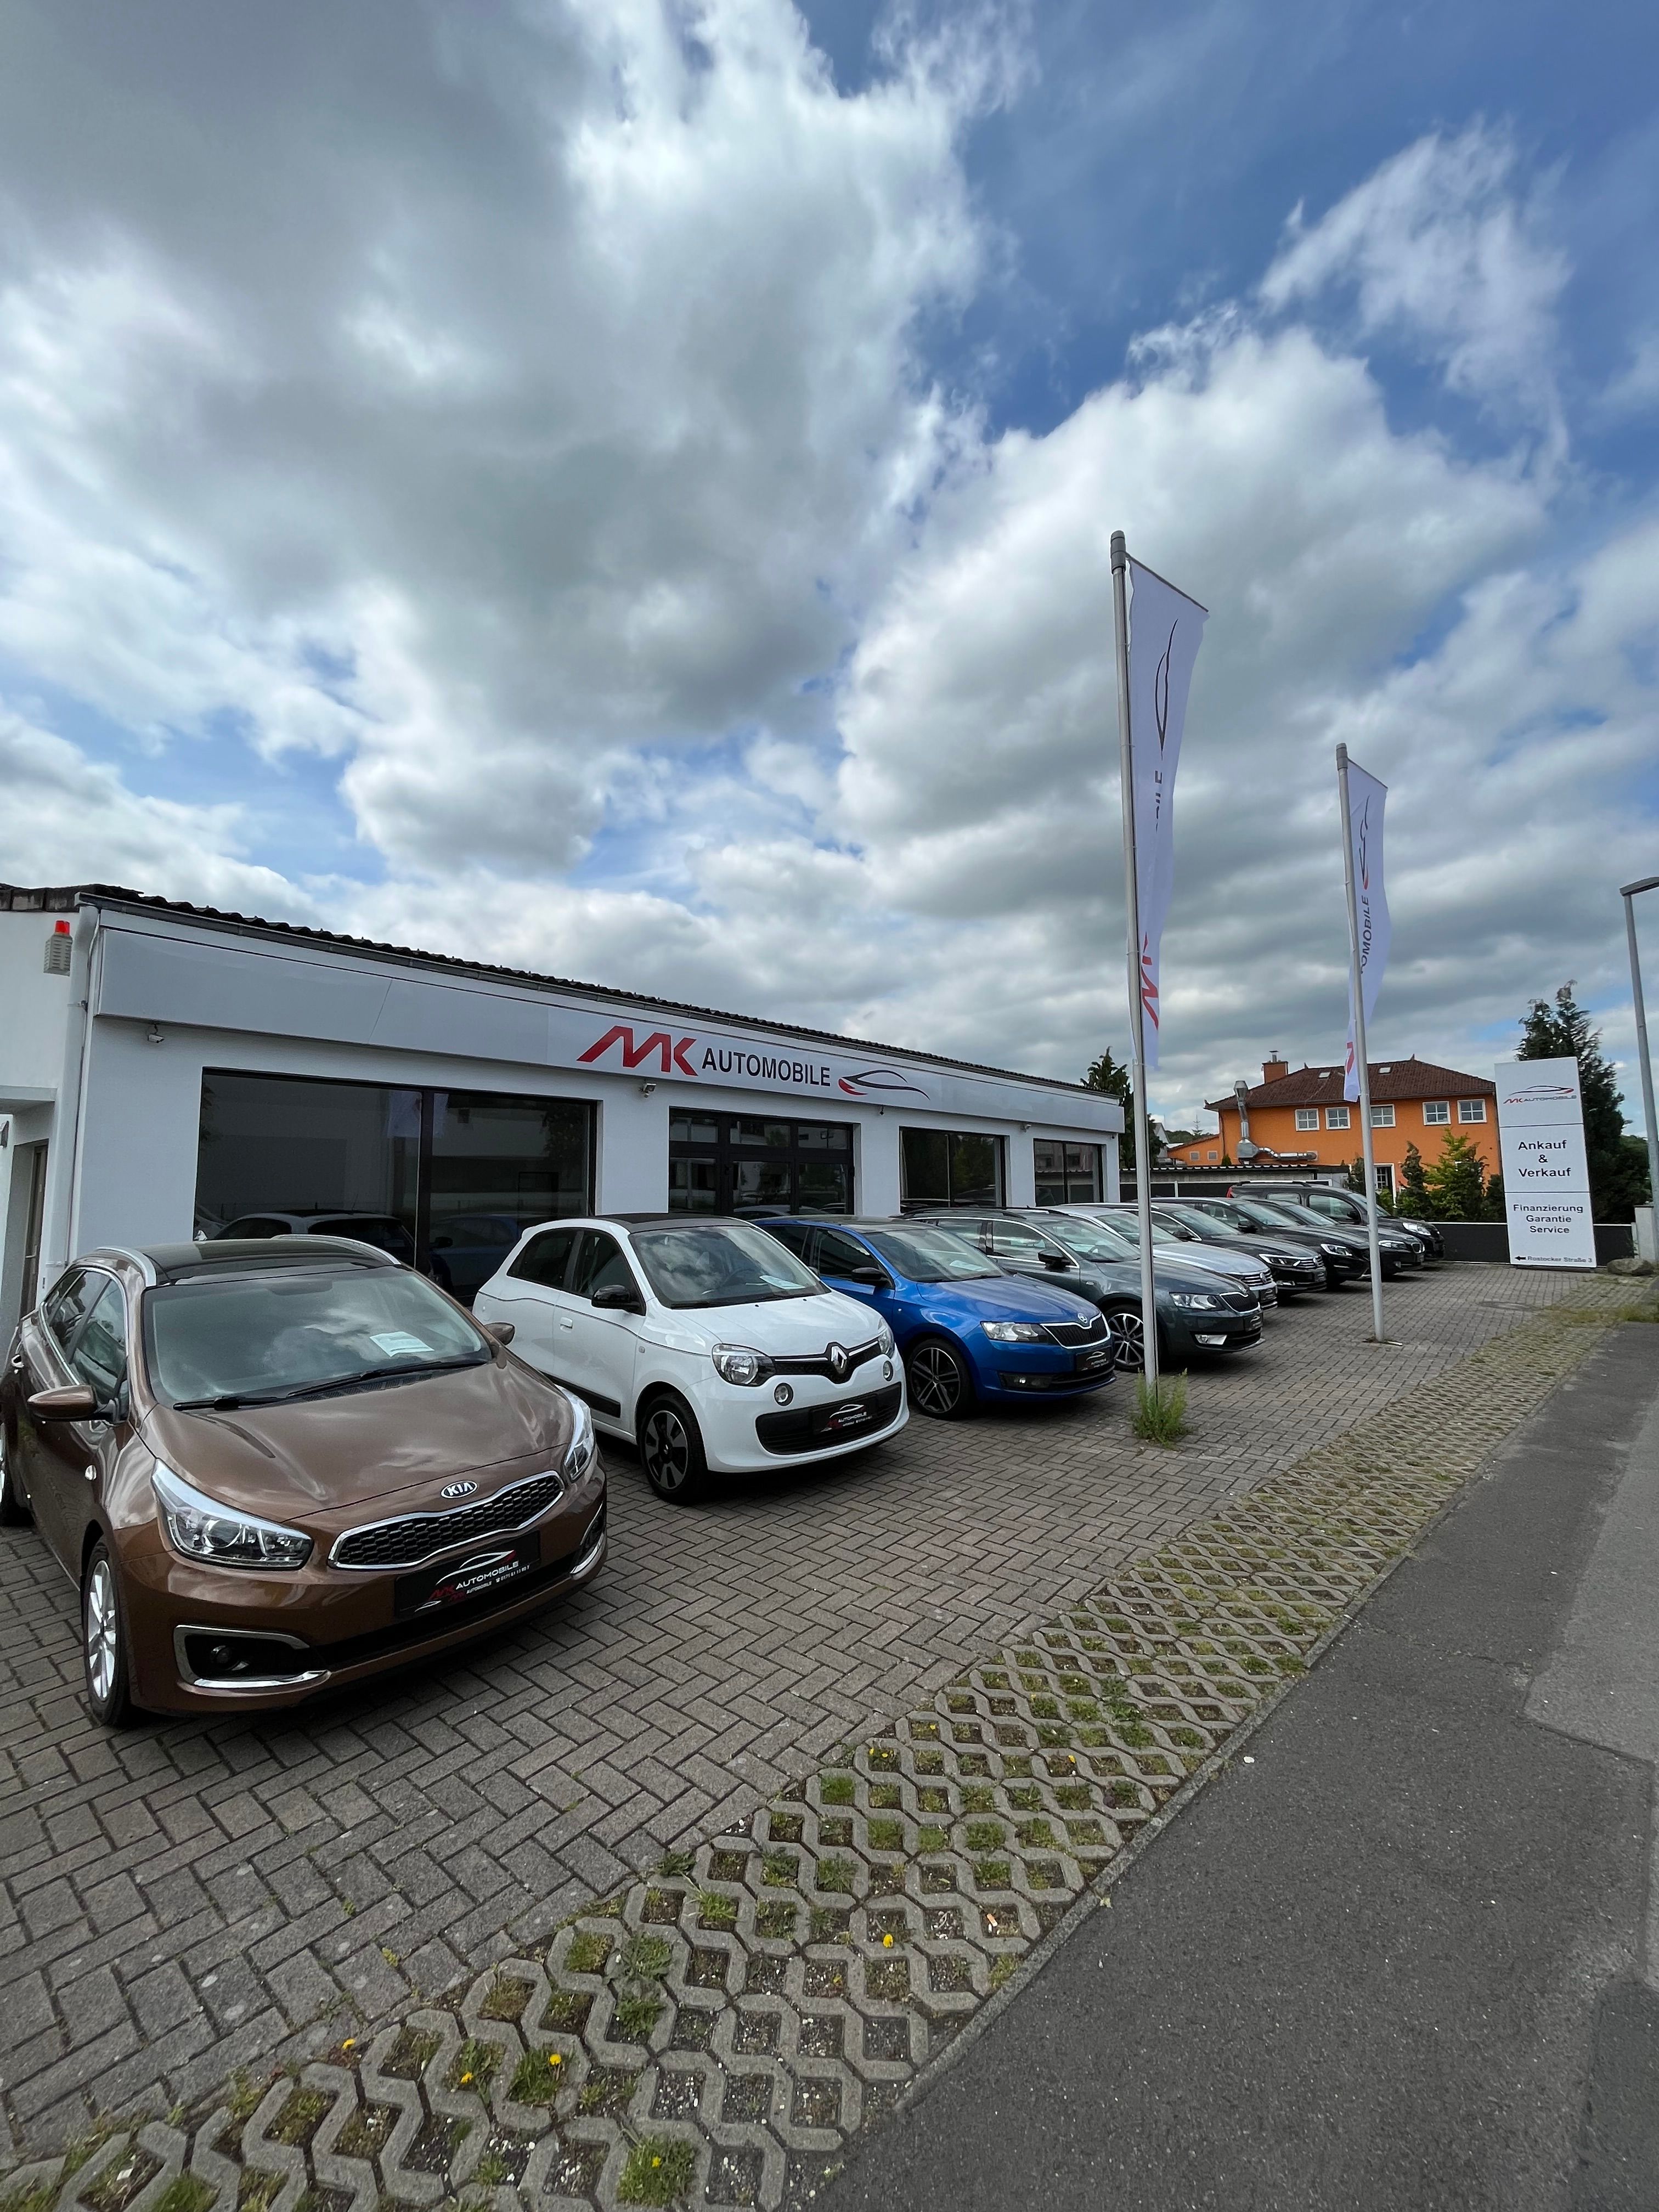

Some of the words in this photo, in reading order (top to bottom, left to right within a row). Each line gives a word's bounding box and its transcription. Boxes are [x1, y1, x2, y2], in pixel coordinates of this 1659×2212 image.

[1361, 895, 1372, 974] OMOBILE
[577, 1025, 698, 1076] MK
[702, 1047, 831, 1087] AUTOMOBILE
[1518, 1139, 1567, 1150] Ankauf
[1538, 1154, 1548, 1164] &
[1519, 1168, 1571, 1177] Verkauf
[1513, 1204, 1584, 1214] Finanzierung
[448, 1483, 472, 1497] KIA
[456, 1561, 519, 1589] AUTOMOBILE
